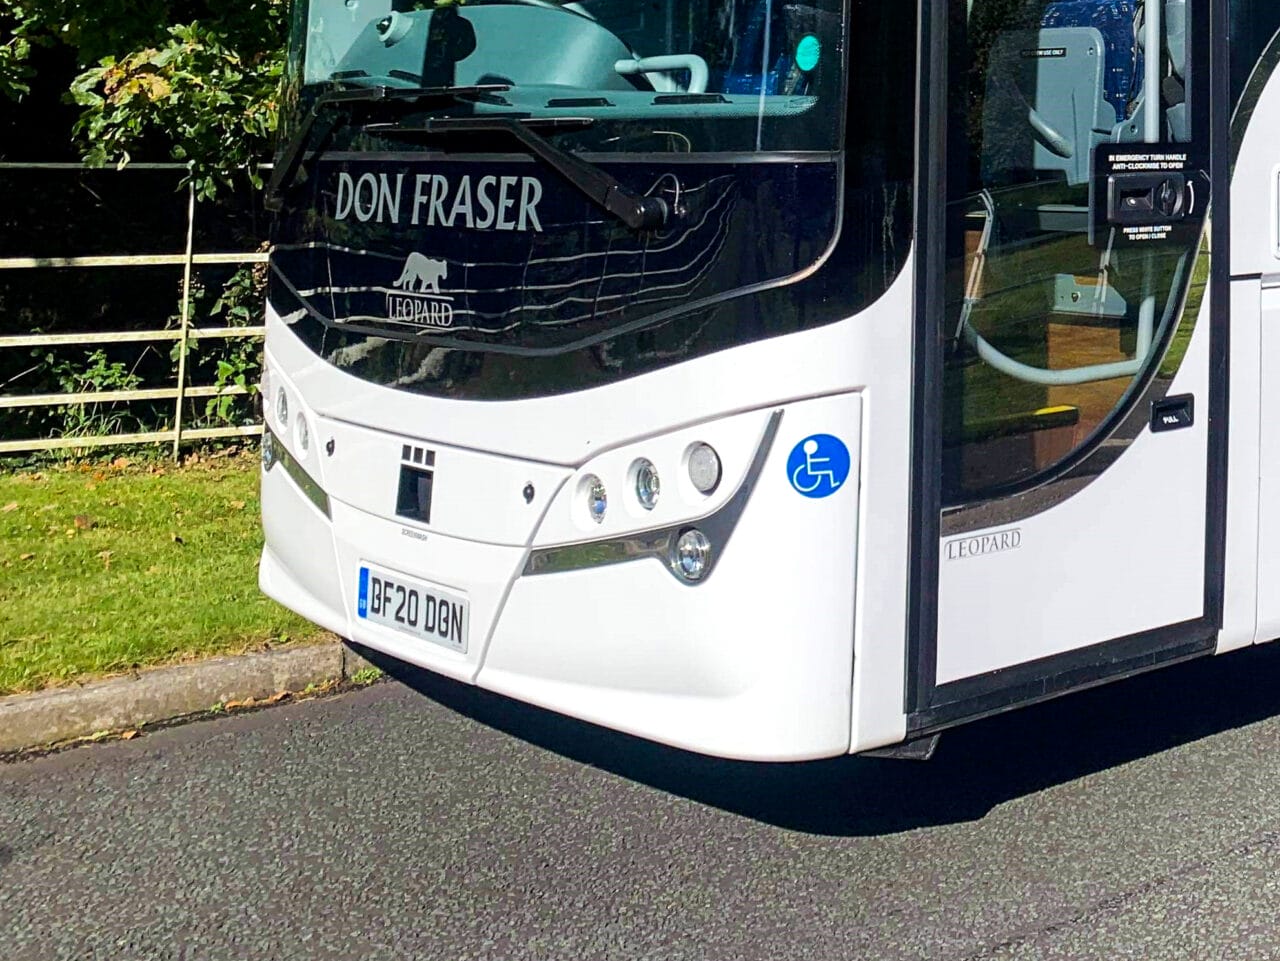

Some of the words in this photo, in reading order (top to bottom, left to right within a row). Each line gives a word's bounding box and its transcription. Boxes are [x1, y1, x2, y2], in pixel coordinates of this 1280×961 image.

[334, 172, 403, 224] DON
[410, 173, 544, 233] FRASER
[388, 296, 453, 327] LEOPARD
[1162, 415, 1180, 425] PULL
[948, 530, 1022, 560] LEOPARD
